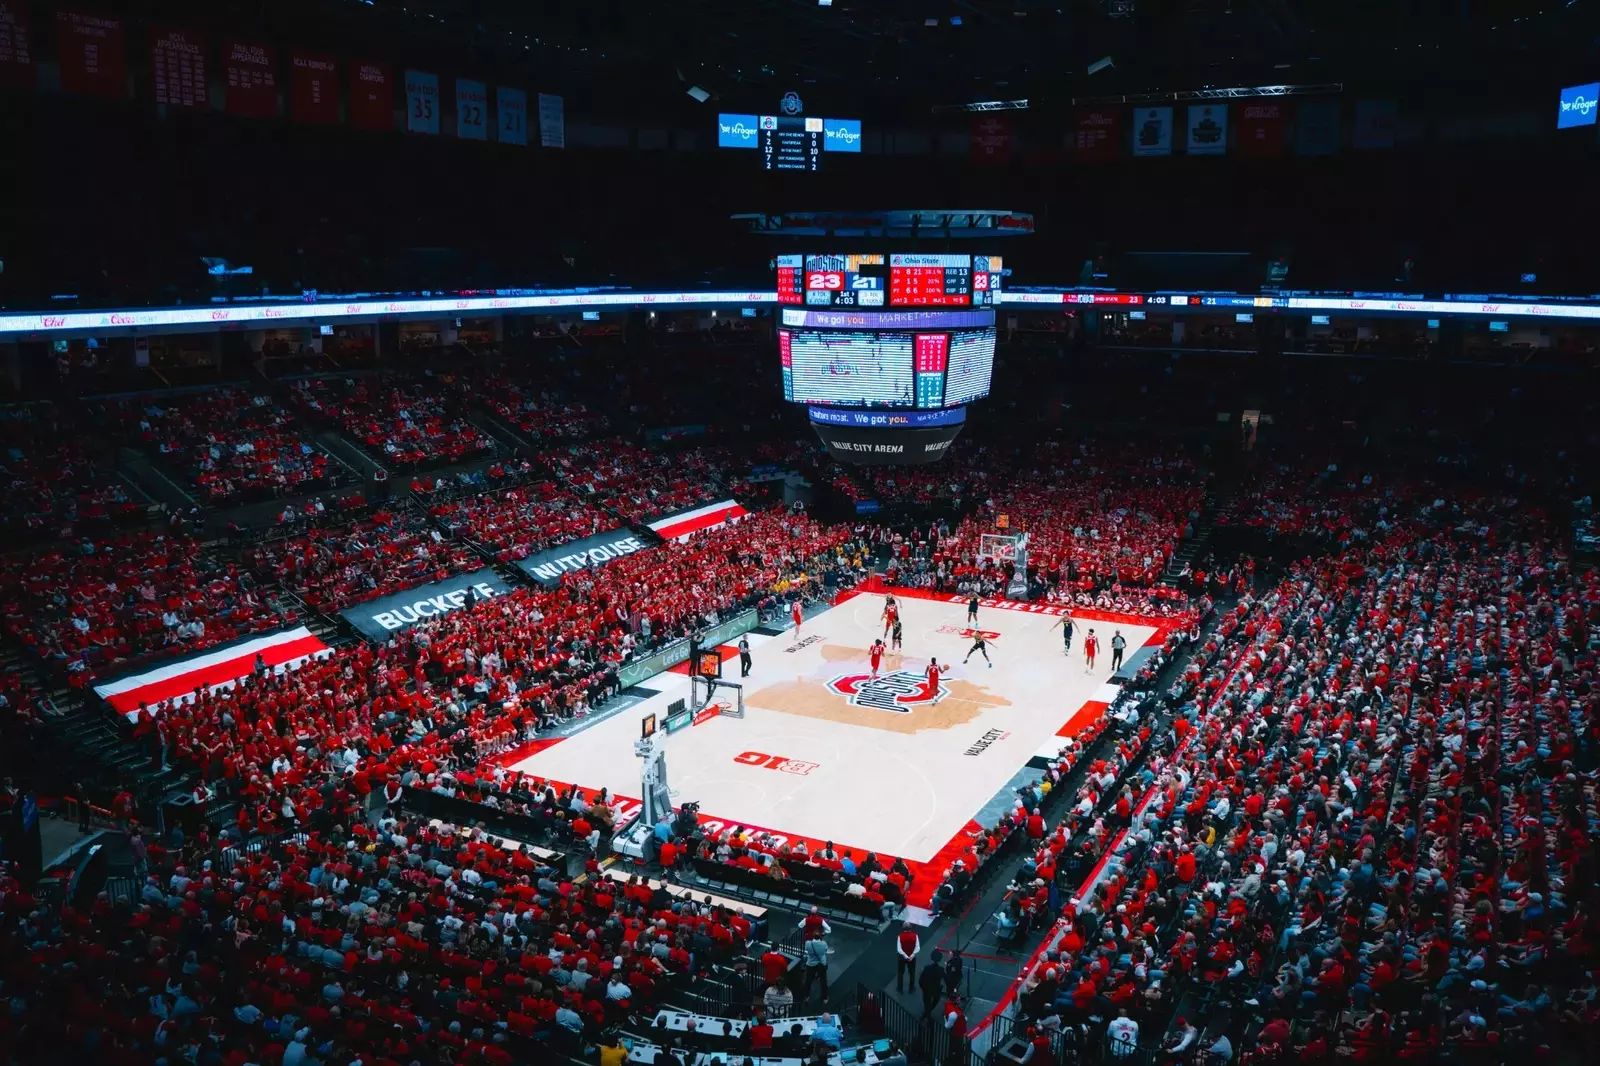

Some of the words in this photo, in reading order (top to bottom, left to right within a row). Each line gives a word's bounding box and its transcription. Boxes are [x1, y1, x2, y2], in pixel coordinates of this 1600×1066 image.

[414, 98, 432, 119] 35
[1572, 96, 1597, 115] Kroger
[463, 104, 482, 126] 22
[504, 112, 521, 133] 21
[732, 123, 757, 139] Kroger
[836, 128, 860, 143] Kroger
[810, 274, 841, 289] 23
[852, 274, 877, 289] 21
[975, 275, 987, 289] 23
[991, 275, 1000, 289] 21
[835, 297, 854, 305] 4:03
[1129, 296, 1138, 304] 23
[1207, 297, 1216, 305] 21
[817, 314, 829, 324] We
[831, 315, 845, 326] got
[854, 414, 869, 423] We
[871, 415, 887, 425] got
[888, 416, 908, 425] you.
[831, 440, 853, 451] VALUE
[854, 444, 872, 452] CITY
[874, 445, 904, 453] ARENA
[925, 442, 944, 452] VALUE
[530, 536, 645, 581] NUTHOUSE
[662, 652, 678, 666] Let's
[679, 647, 690, 661] Go
[963, 740, 992, 757] VALUE
[982, 728, 1004, 741] CITY
